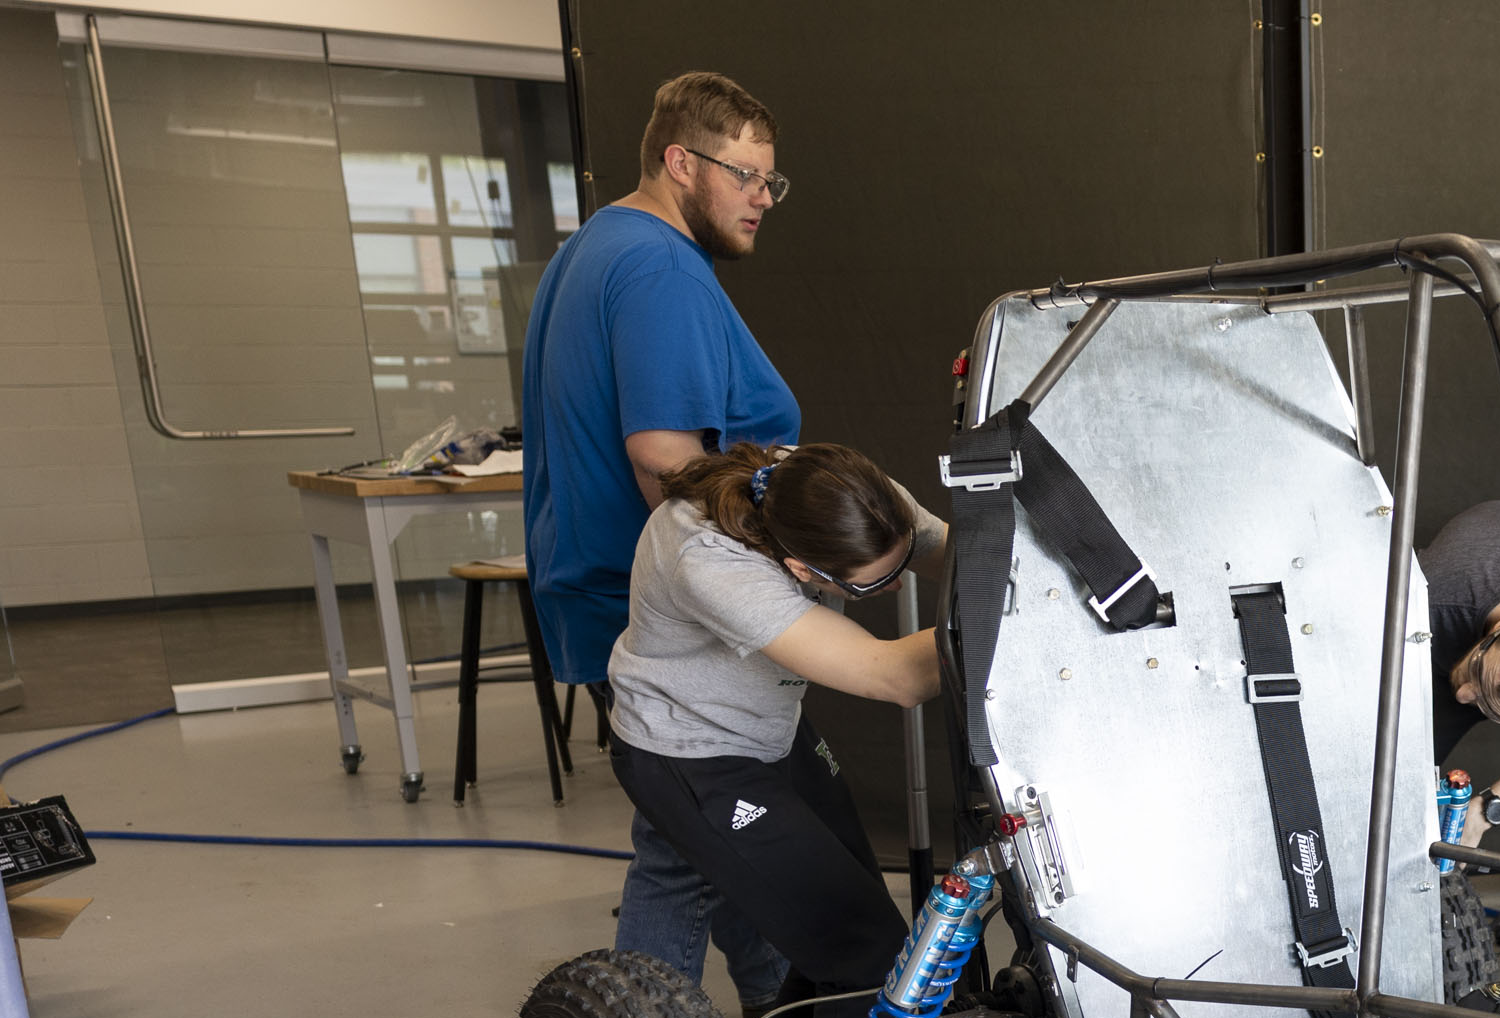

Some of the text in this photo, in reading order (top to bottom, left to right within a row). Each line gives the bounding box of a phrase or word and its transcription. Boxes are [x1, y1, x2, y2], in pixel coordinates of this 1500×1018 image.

[732, 806, 767, 830] adidas
[1296, 833, 1319, 908] SPEEDWAY
[908, 923, 957, 998] KING
